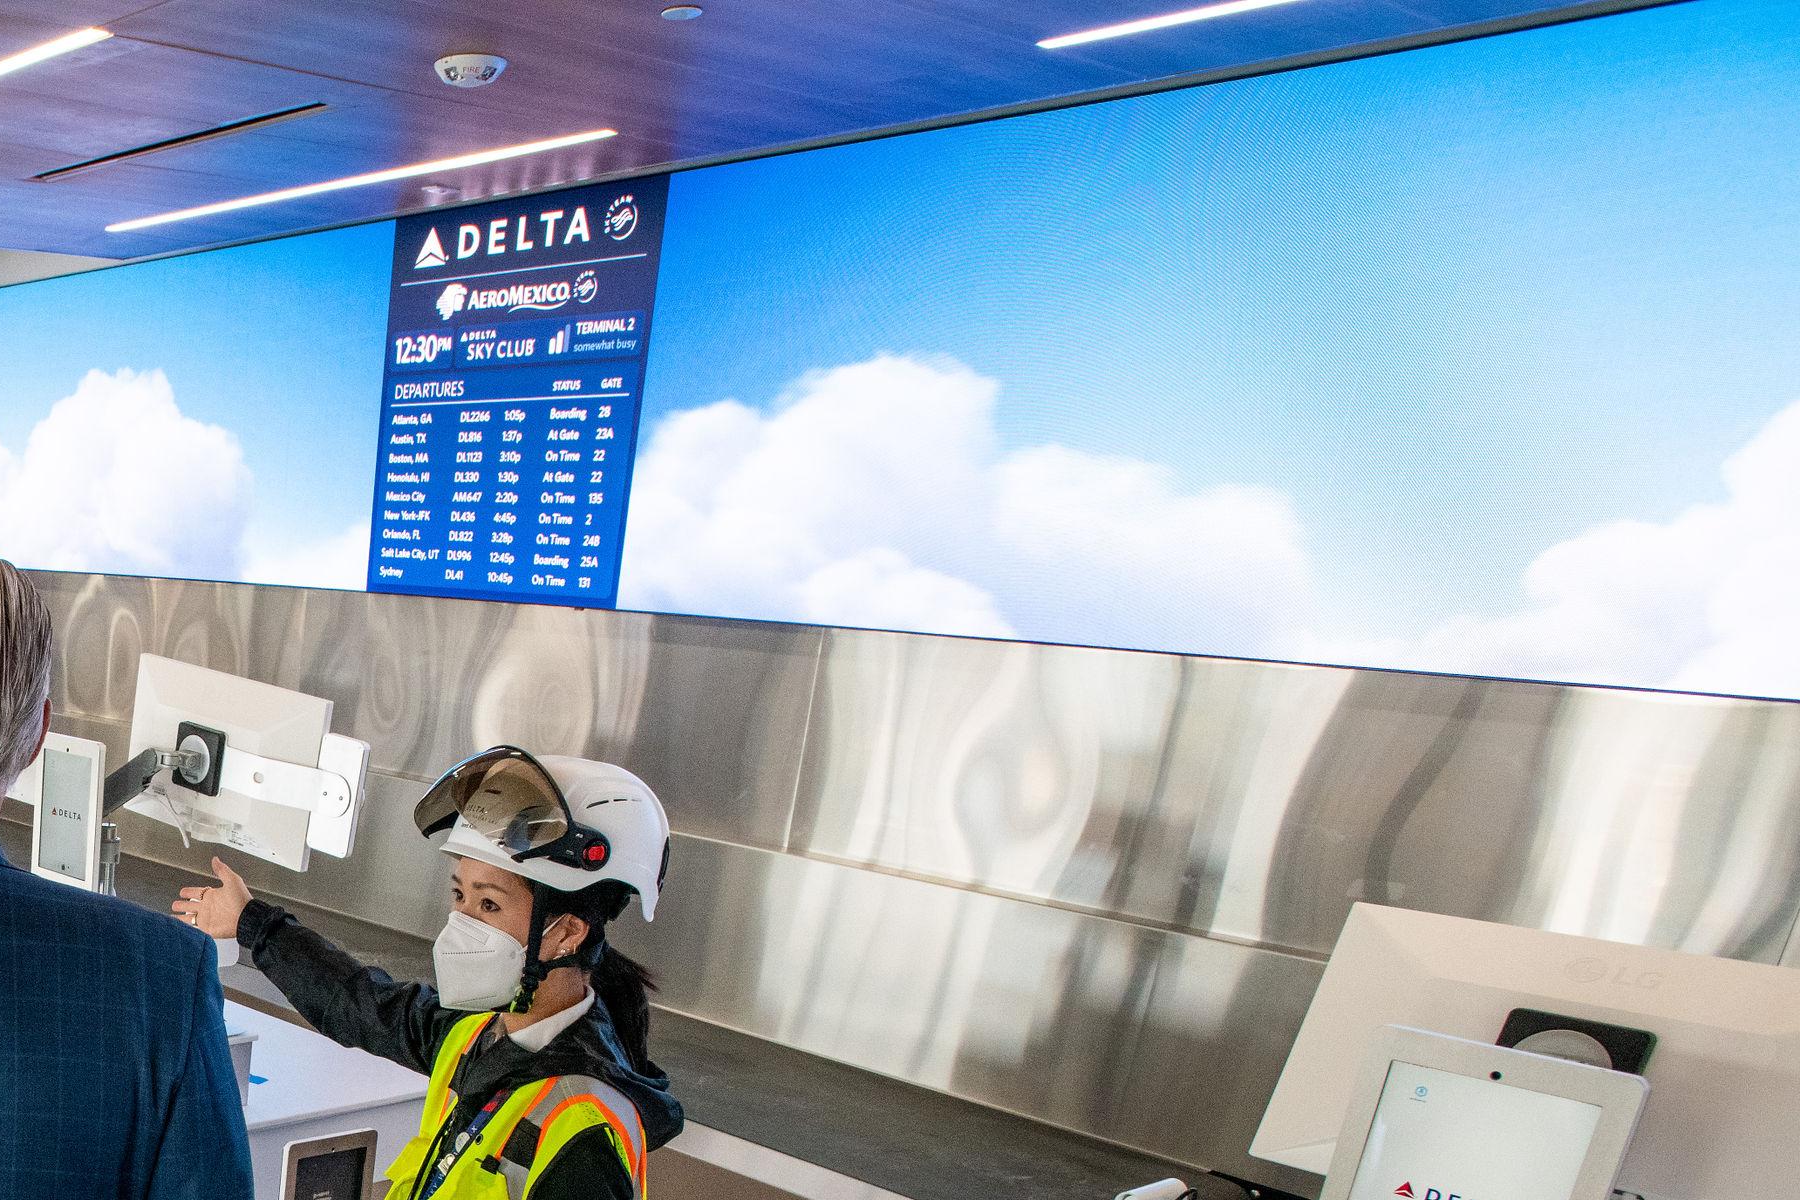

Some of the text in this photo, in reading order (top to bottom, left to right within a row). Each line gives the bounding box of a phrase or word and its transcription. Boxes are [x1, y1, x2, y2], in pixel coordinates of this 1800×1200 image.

[462, 66, 481, 74] FIRE
[457, 206, 590, 259] DELTA
[467, 284, 570, 310] AEROMEXICO
[576, 317, 636, 335] TERMINAL 2
[469, 330, 496, 341] DELTA
[466, 339, 535, 361] SKY CLUB
[573, 338, 637, 353] somewhat busy
[395, 380, 465, 400] DEPARTURES
[552, 377, 624, 391] STATUS GATE
[392, 414, 418, 426] Atlanta,
[420, 413, 432, 424] GA
[504, 409, 526, 422] 1:05p
[550, 407, 587, 421] Boarding
[390, 434, 414, 445] Austin,
[416, 433, 427, 444] TX
[502, 430, 522, 443] 1:37p
[547, 429, 558, 441] At
[559, 428, 580, 441] Gate
[595, 427, 614, 440] 23A
[388, 453, 414, 465] Boston,
[415, 452, 429, 463] MA
[499, 451, 521, 464] 3:10p
[545, 450, 558, 462] On
[559, 450, 581, 462] Time
[592, 449, 606, 462] 22
[387, 472, 419, 484] Honolulu,
[421, 472, 430, 483] HI
[497, 471, 519, 484] 1:30p
[542, 472, 554, 483] At
[554, 471, 575, 483] Gate
[589, 471, 603, 483] 22
[385, 491, 410, 502] Mexico
[411, 490, 426, 504] City
[495, 491, 519, 505] 2:20p
[540, 491, 554, 504] On
[554, 492, 576, 504] Time
[384, 510, 400, 521] New
[401, 510, 431, 522] York-JFK
[493, 512, 517, 525] 4:45p
[538, 512, 551, 525] On
[552, 513, 573, 525] Time
[584, 513, 593, 526] 2
[382, 529, 411, 541] Orlando,
[412, 530, 421, 540] FL
[535, 533, 549, 545] On
[550, 534, 571, 546] Time
[381, 547, 395, 558] Salt
[395, 548, 411, 559] Lake
[411, 549, 427, 561] City,
[428, 549, 440, 560] UT
[489, 551, 515, 566] 12:45p
[533, 553, 570, 569] Boarding
[379, 566, 403, 579] Sydney
[445, 569, 464, 581] DL41
[487, 571, 513, 585] 10:45p
[531, 574, 544, 586] On
[545, 575, 566, 587] Time
[58, 808, 82, 821] DELTA
